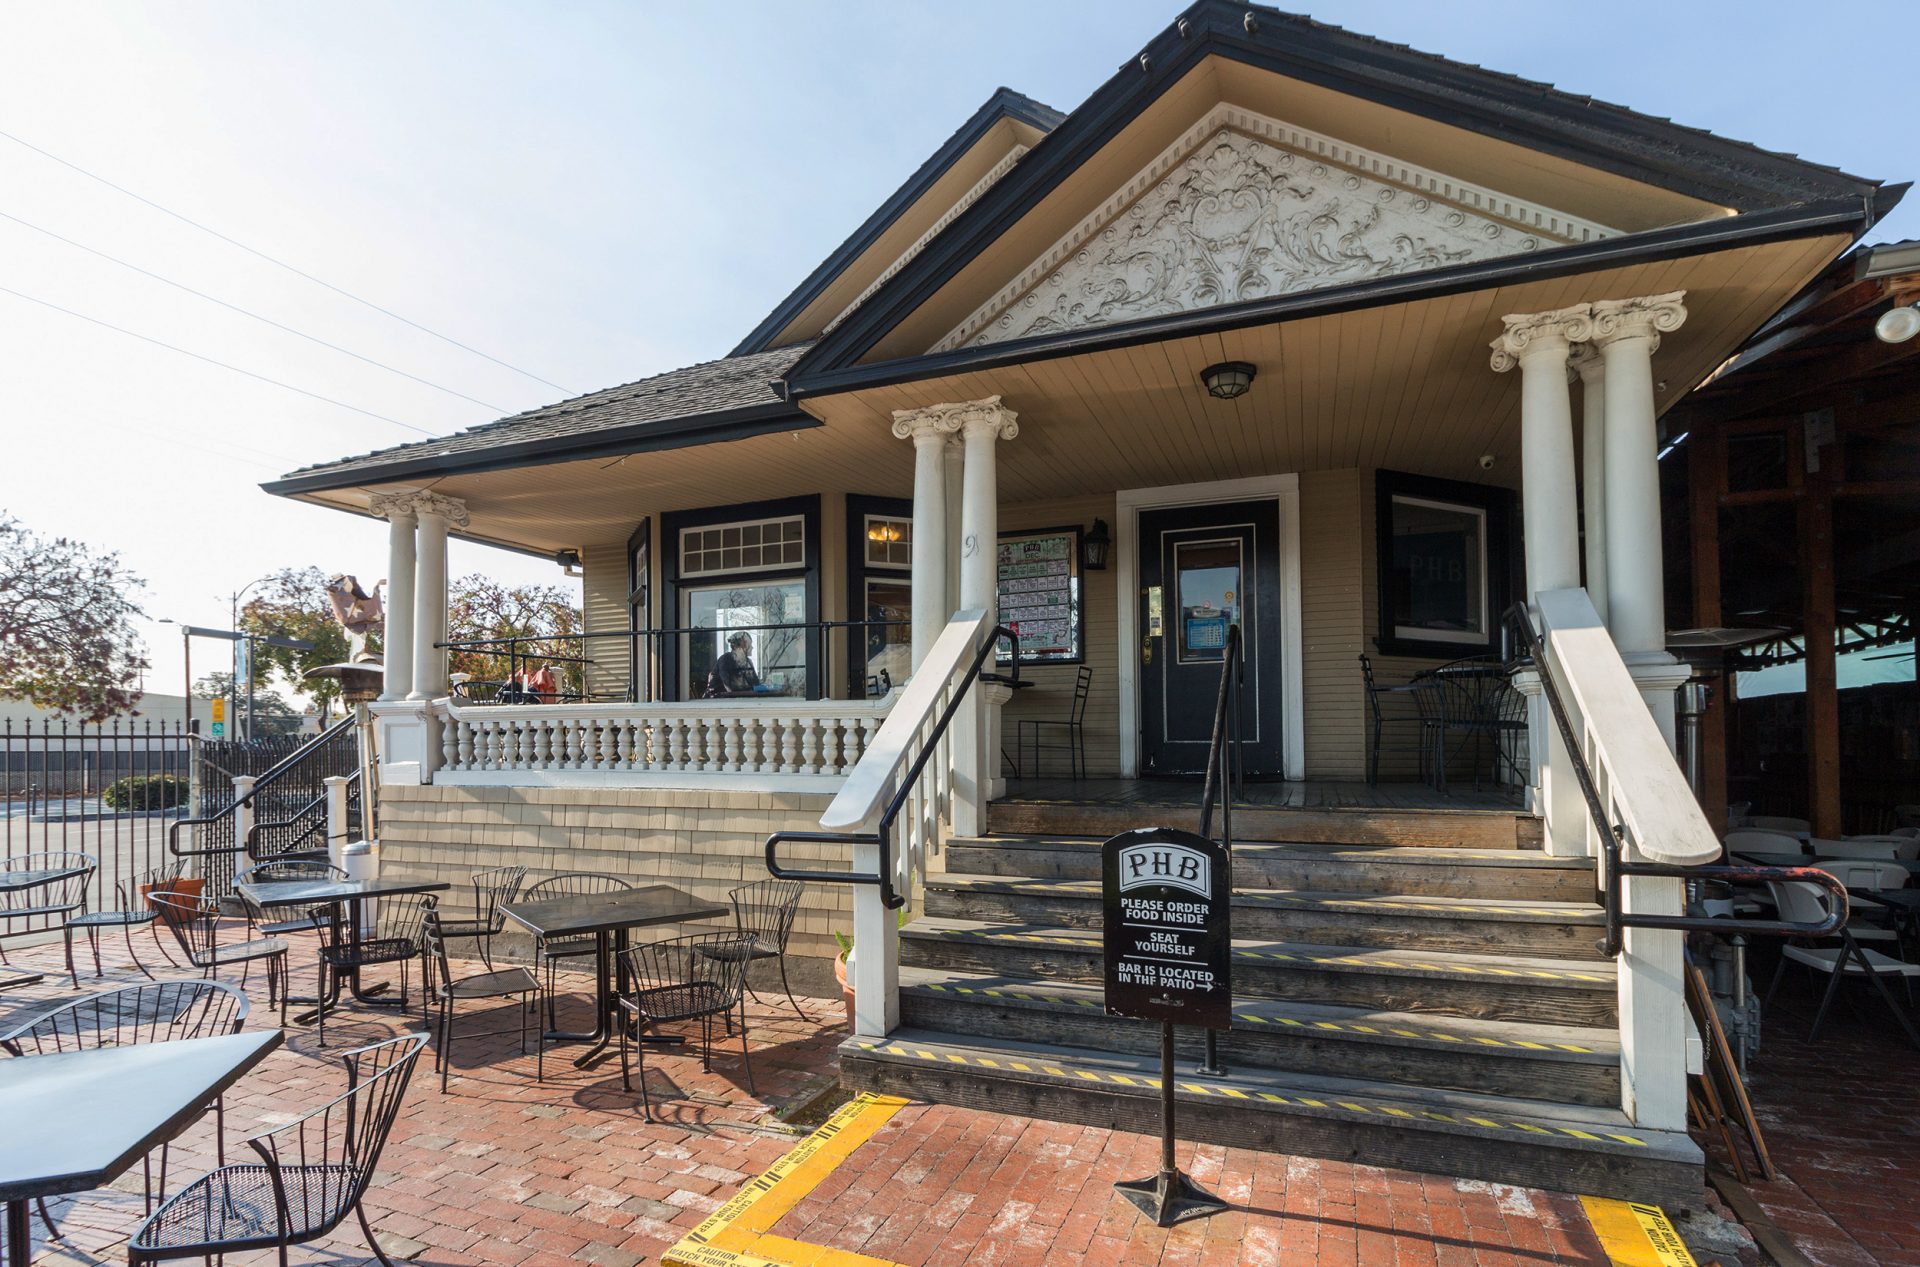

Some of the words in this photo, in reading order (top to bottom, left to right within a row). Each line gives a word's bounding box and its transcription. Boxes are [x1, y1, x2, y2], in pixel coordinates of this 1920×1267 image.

[1128, 851, 1200, 881] PHB
[1121, 898, 1164, 911] PLEASE
[1167, 901, 1209, 915] ORDER
[1126, 908, 1159, 920] FOOD
[1162, 911, 1204, 925] INSIDE
[1150, 932, 1179, 944] SEAT
[1135, 940, 1195, 956] YOURSELF
[1118, 962, 1141, 974] BAR
[1145, 965, 1156, 975] IS
[1160, 966, 1214, 982] LOCATED
[1118, 972, 1131, 983] IN
[1160, 977, 1195, 990] PATIO
[732, 1187, 757, 1204] WATCH
[714, 1204, 733, 1218] YOUR
[722, 1199, 752, 1223] CAUTION
[699, 1218, 718, 1233] STEP
[1652, 1217, 1670, 1231] STEP
[1645, 1228, 1670, 1253] CAUTION
[668, 1248, 702, 1261] WATCH
[702, 1256, 728, 1267] YOUR
[697, 1246, 738, 1261] CAUTION
